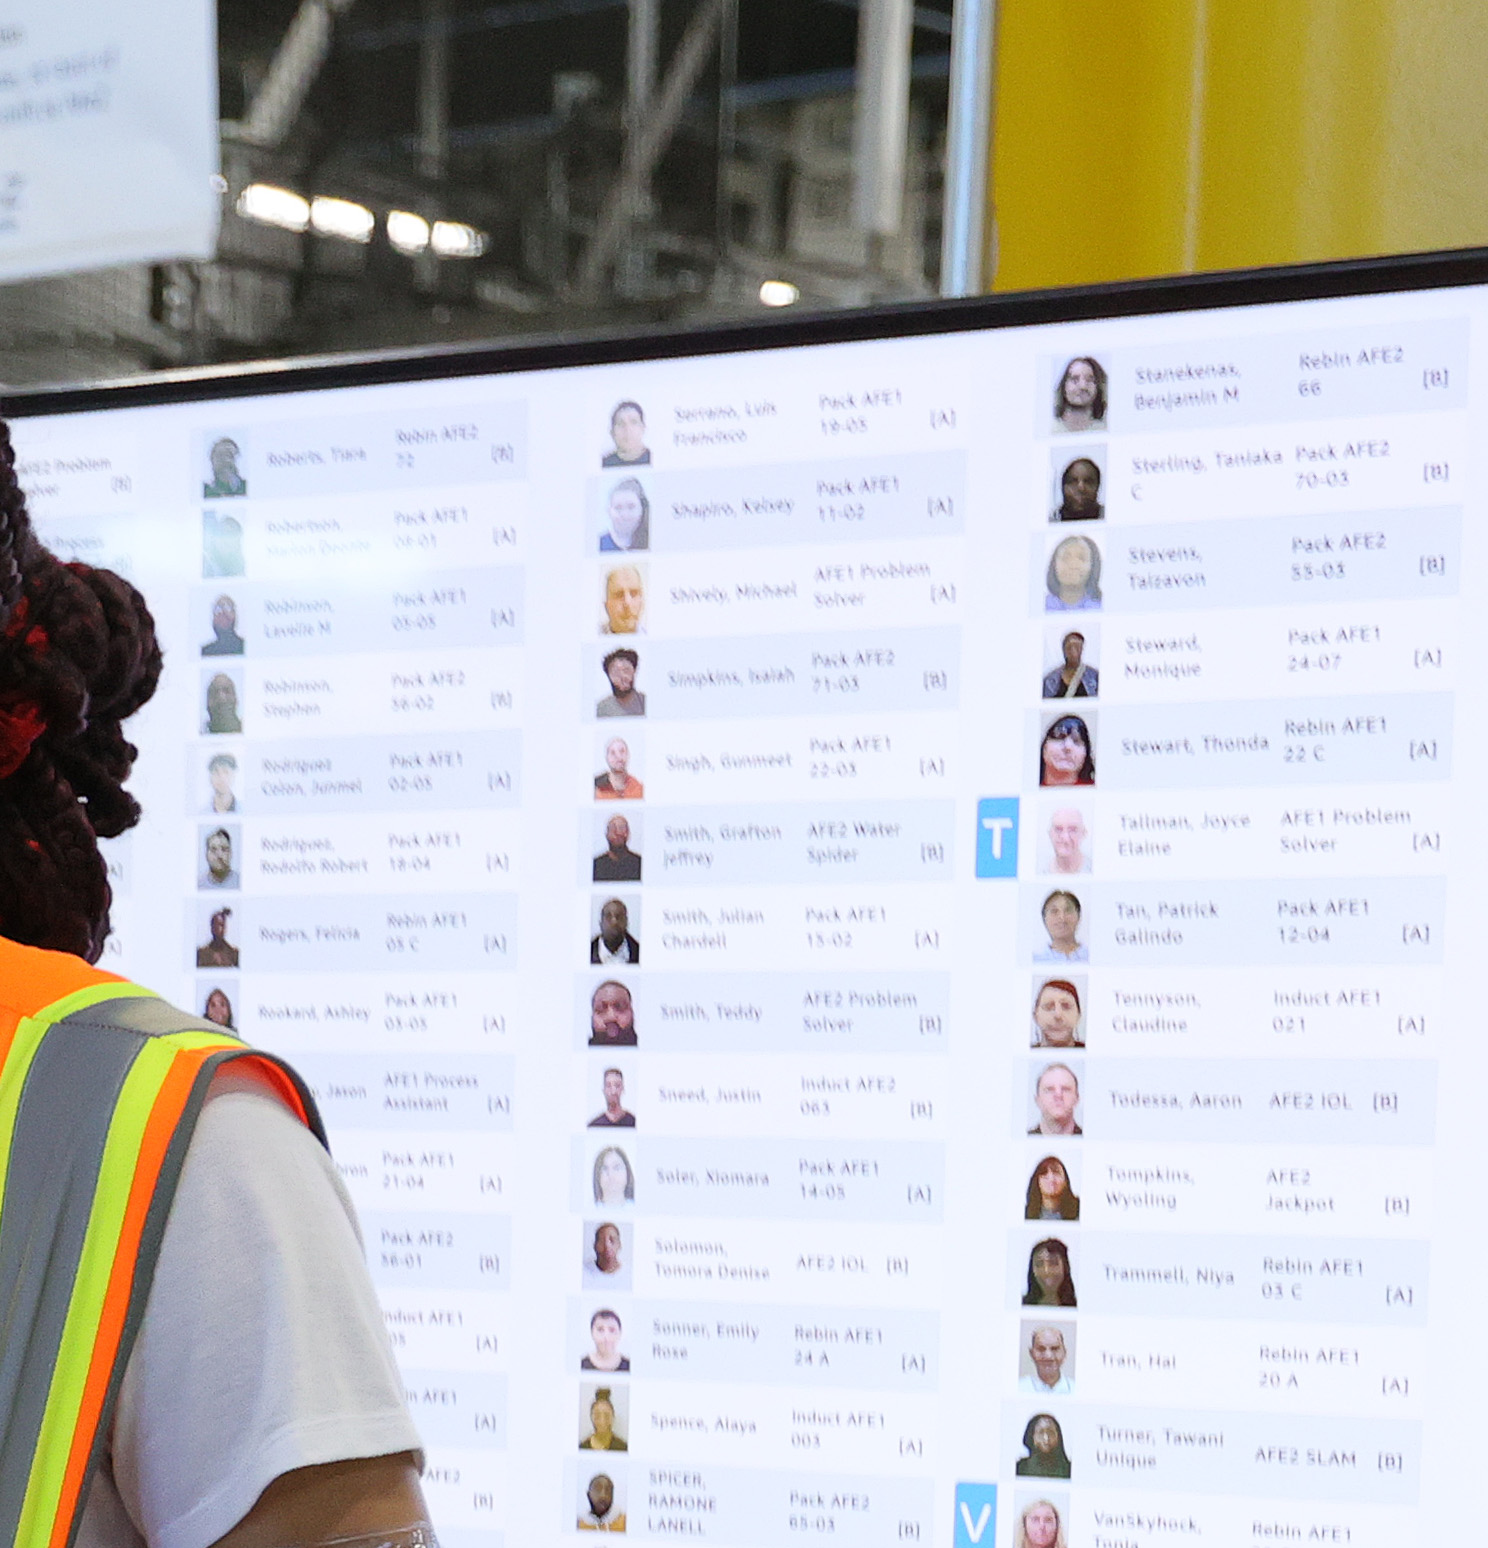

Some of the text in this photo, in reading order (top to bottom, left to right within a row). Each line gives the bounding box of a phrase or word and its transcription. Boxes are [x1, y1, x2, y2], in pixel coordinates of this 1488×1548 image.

[1356, 345, 1404, 364] AFE2
[1132, 390, 1218, 410] Benjamin
[1293, 439, 1390, 461] Pack AFE2
[1130, 455, 1207, 474] Sterling,
[1290, 532, 1387, 552] Pack AFE2
[1127, 546, 1203, 564] Stevens,
[814, 562, 931, 581] AFE1 Problem
[734, 582, 798, 598] Michael
[812, 591, 865, 607] Solver
[1286, 625, 1381, 644] Pack AFE1
[810, 653, 849, 667] Pack
[1286, 653, 1342, 672] 24-07
[1122, 662, 1202, 680] Monique
[1282, 716, 1387, 736] Rebin AFE1
[808, 736, 891, 752] Pack AFE1
[1120, 737, 1195, 755] Stewart,
[1407, 738, 1439, 761] [A]
[1119, 813, 1251, 830] Tallman, Joyce
[1279, 807, 1412, 826] AFE1 Problem
[663, 825, 782, 843] Smith, Grafton
[806, 823, 901, 837] AFE2 Water
[980, 817, 1014, 859] T
[1116, 840, 1172, 856] Elaine
[1278, 835, 1337, 852] Solver
[1410, 831, 1441, 852] [A]
[805, 845, 859, 866] Spider
[803, 907, 886, 920] Pack AFE1
[1115, 902, 1219, 920] Tan, Patrick
[1275, 899, 1370, 915] Pack AFE1
[385, 913, 468, 928] Rebin AFE1
[661, 908, 765, 925] Smith, Julian
[913, 930, 940, 949] [A]
[1113, 927, 1184, 945] Galindo
[1277, 925, 1331, 943] 12-04
[1400, 923, 1431, 945] [A]
[383, 994, 458, 1005] Pack AFE1
[801, 992, 918, 1006] AFE2 Problem
[1112, 990, 1201, 1009] Tennyson,
[1272, 990, 1381, 1005] Induct AFE1
[323, 1006, 370, 1022] Ashley
[658, 1003, 763, 1022] Smith, Teddy
[801, 1015, 853, 1032] Solver
[1110, 1016, 1188, 1032] Claudine
[1395, 1015, 1426, 1035] [A]
[382, 1073, 479, 1087] AFE1 Process
[799, 1077, 896, 1090] Induct AFE2
[381, 1094, 449, 1111] Assistant
[657, 1087, 762, 1105] Sneed, Justin
[1188, 1093, 1243, 1107] Aaron
[1267, 1093, 1315, 1108] AFE2
[380, 1153, 455, 1165] Pack AFE1
[797, 1160, 880, 1174] Pack AFE1
[1106, 1165, 1194, 1185] Tompkins,
[1265, 1168, 1311, 1185] AFE2
[478, 1176, 503, 1193] [A]
[905, 1184, 933, 1205] [A]
[1262, 1194, 1335, 1214] Jackpot
[379, 1230, 454, 1246] Pack AFE2
[653, 1238, 729, 1256] Solomon,
[715, 1264, 770, 1279] Denise
[795, 1256, 837, 1269] AFE2
[1261, 1257, 1364, 1274] Rebin AFE1
[1102, 1264, 1236, 1285] Trammell, Niya
[1383, 1285, 1414, 1307] [A]
[426, 1307, 466, 1327] AFE1
[714, 1322, 760, 1340] Emily
[792, 1325, 883, 1343] Rebin AFE1
[474, 1335, 499, 1352] [A]
[650, 1342, 689, 1359] Rose
[817, 1351, 830, 1365] A
[899, 1353, 927, 1374] [A]
[1100, 1350, 1141, 1369] Tran,
[1257, 1346, 1360, 1363] Rebin AFE1
[1285, 1373, 1299, 1387] A
[1380, 1376, 1410, 1396] [A]
[472, 1413, 498, 1433] [A]
[649, 1413, 710, 1433] Spence,
[790, 1409, 885, 1427] Induct AFE1
[1096, 1424, 1156, 1445] Turner,
[897, 1437, 924, 1456] [A]
[1094, 1449, 1158, 1471] Unique
[1253, 1447, 1357, 1466] AFE2 SLAM
[647, 1469, 707, 1490] SPICER,
[646, 1492, 717, 1512] RAMONE
[787, 1491, 870, 1510] Pack AFE2
[645, 1516, 707, 1535] LANELL
[957, 1500, 993, 1544] V
[1250, 1521, 1352, 1541] Rebin AFE1
